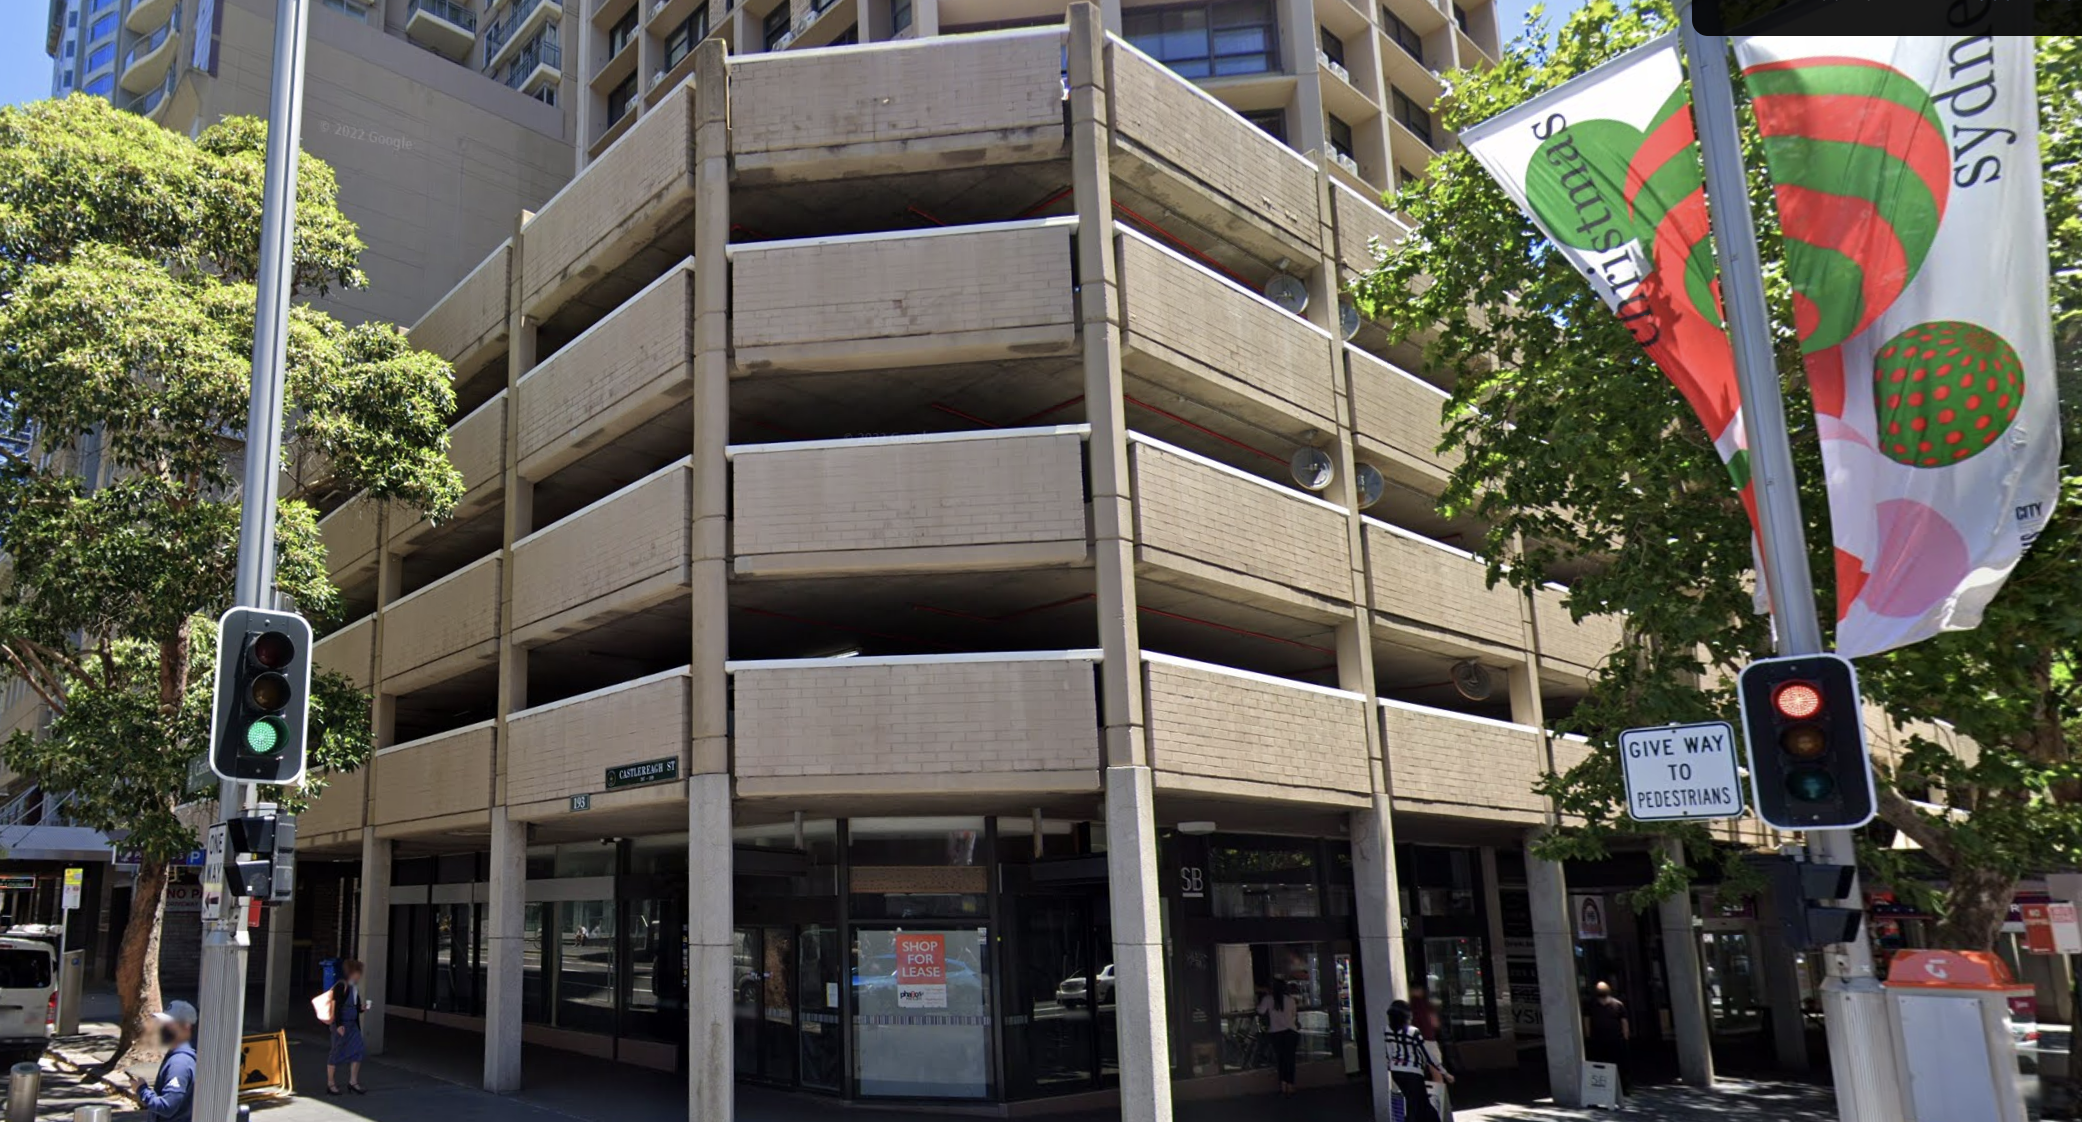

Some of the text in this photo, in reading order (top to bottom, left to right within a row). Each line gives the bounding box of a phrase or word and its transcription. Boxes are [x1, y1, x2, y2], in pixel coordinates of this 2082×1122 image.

[1531, 112, 1660, 348] christmas
[2016, 502, 2043, 520] CITY
[1629, 734, 1724, 758] GIVE WAY
[619, 760, 676, 780] CASTLEREAGH ST
[1667, 763, 1692, 780] TO
[573, 796, 586, 809] 193
[1637, 787, 1731, 808] PEDESTRIANS
[209, 832, 224, 855] ONE
[205, 862, 224, 883] WAY
[1181, 866, 1204, 892] SB
[168, 888, 186, 899] NO
[902, 941, 938, 952] SHOP
[907, 954, 934, 964] FOR
[902, 967, 940, 977] LEASE
